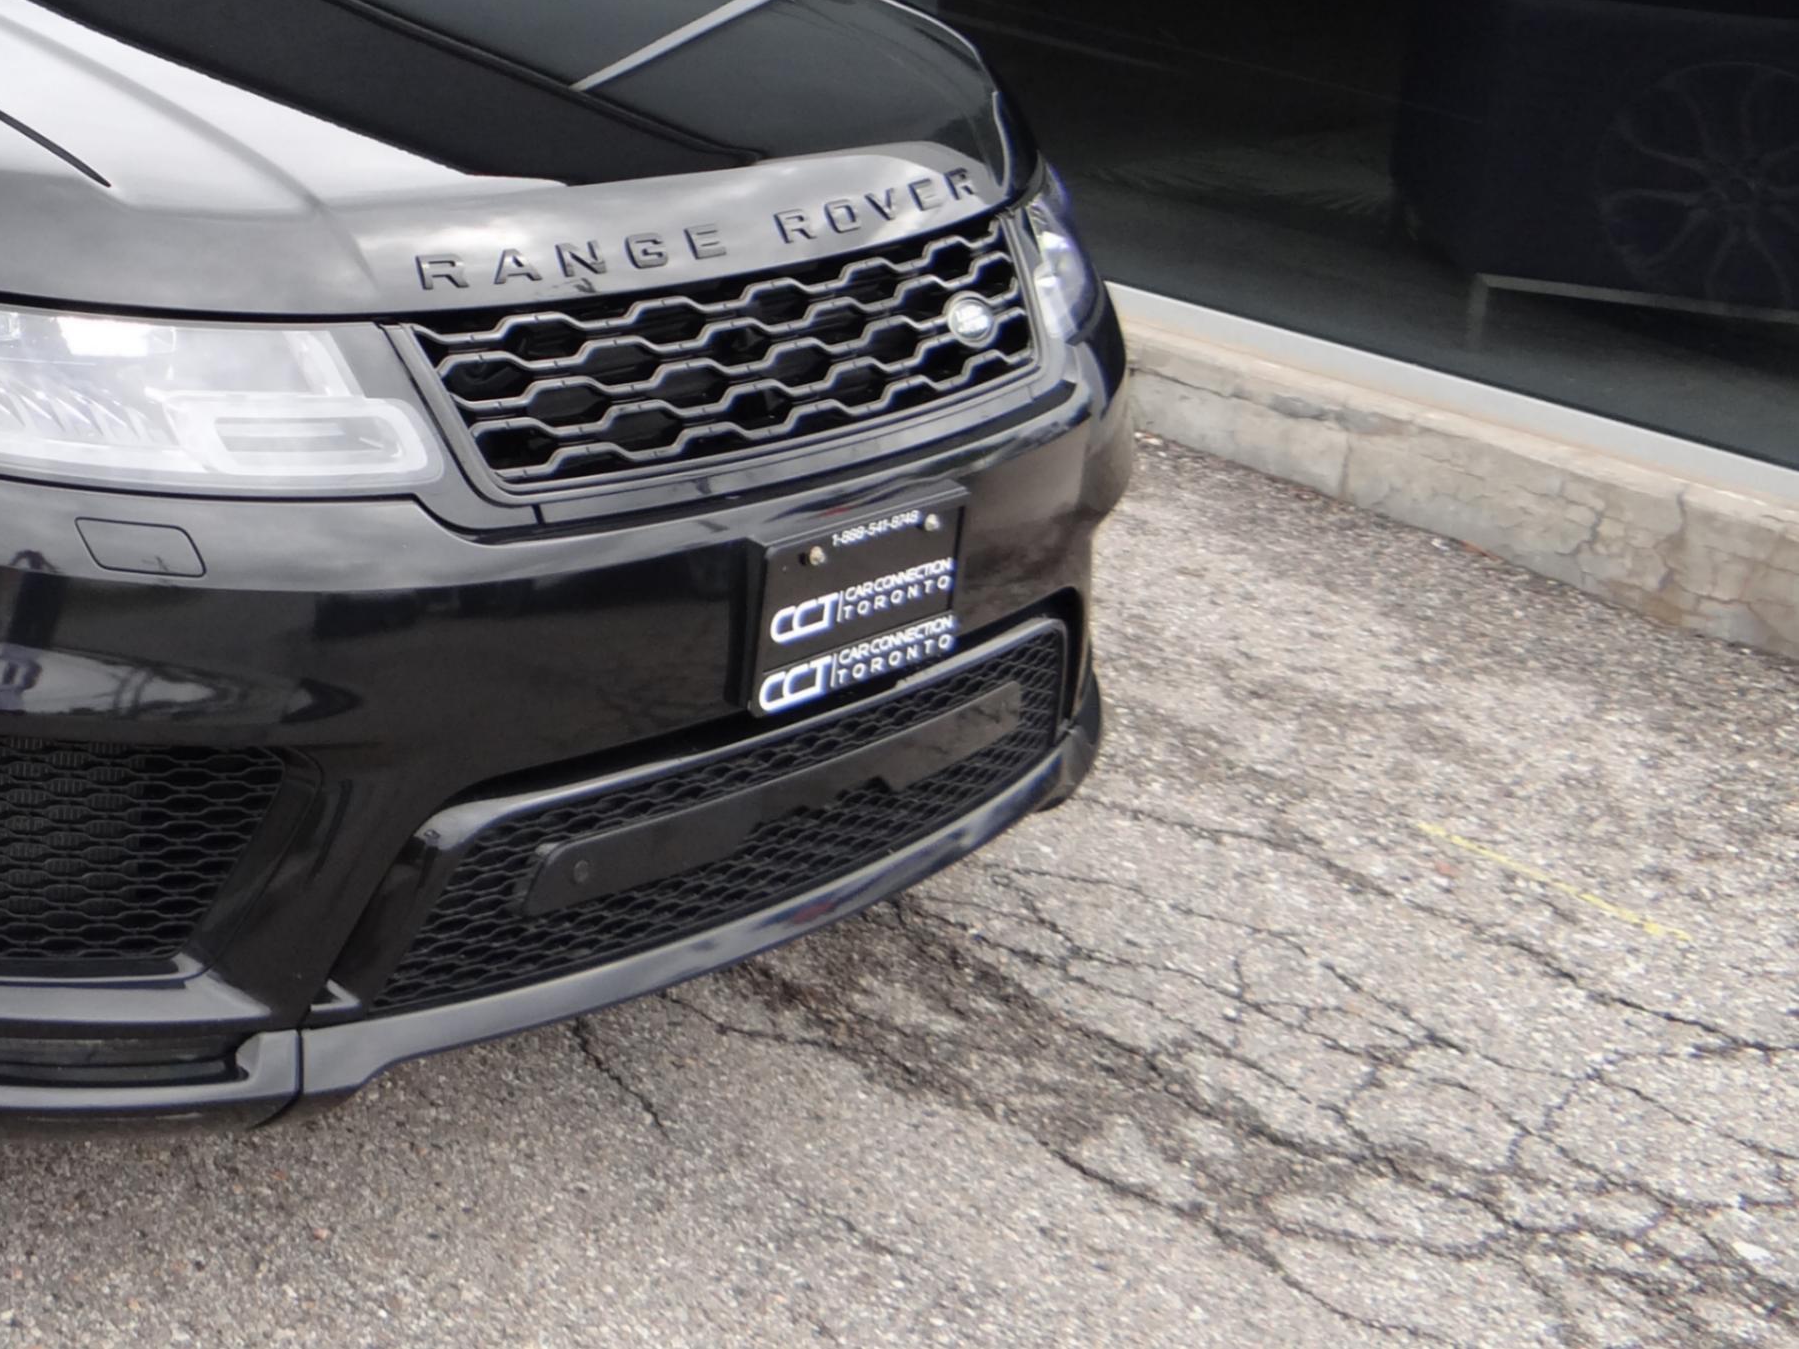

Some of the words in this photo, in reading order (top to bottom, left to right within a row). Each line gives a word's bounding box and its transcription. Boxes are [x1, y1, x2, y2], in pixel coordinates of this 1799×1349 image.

[415, 222, 728, 291] RANGE
[773, 166, 980, 244] ROVER
[769, 591, 840, 643] CCT
[843, 574, 953, 620] TORONTO
[758, 654, 834, 711] CCT
[836, 633, 955, 684] TORONTO
